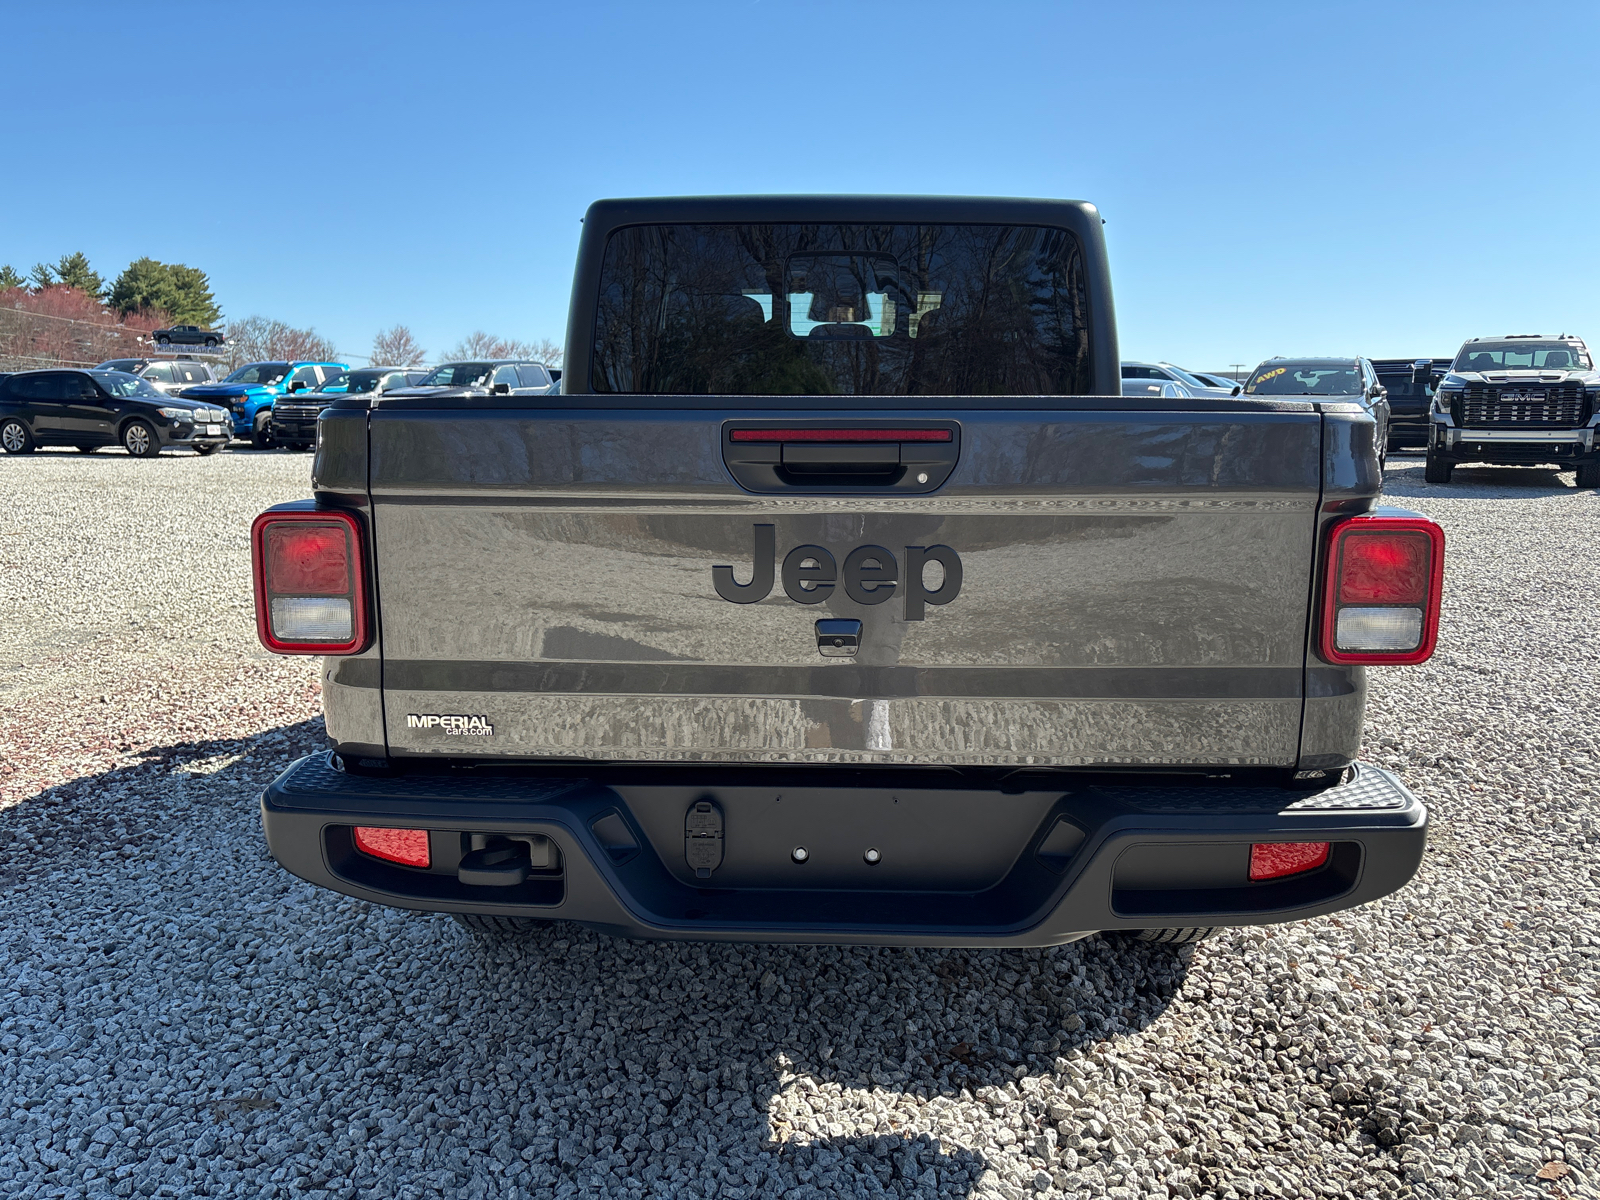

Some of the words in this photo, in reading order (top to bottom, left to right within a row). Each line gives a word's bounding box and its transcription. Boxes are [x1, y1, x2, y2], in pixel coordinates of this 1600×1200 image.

[1255, 367, 1287, 384] AWD
[1500, 393, 1546, 401] GMC
[712, 523, 963, 621] Jeep
[406, 714, 493, 729] IMPERIAL
[446, 728, 493, 736] cars.com
